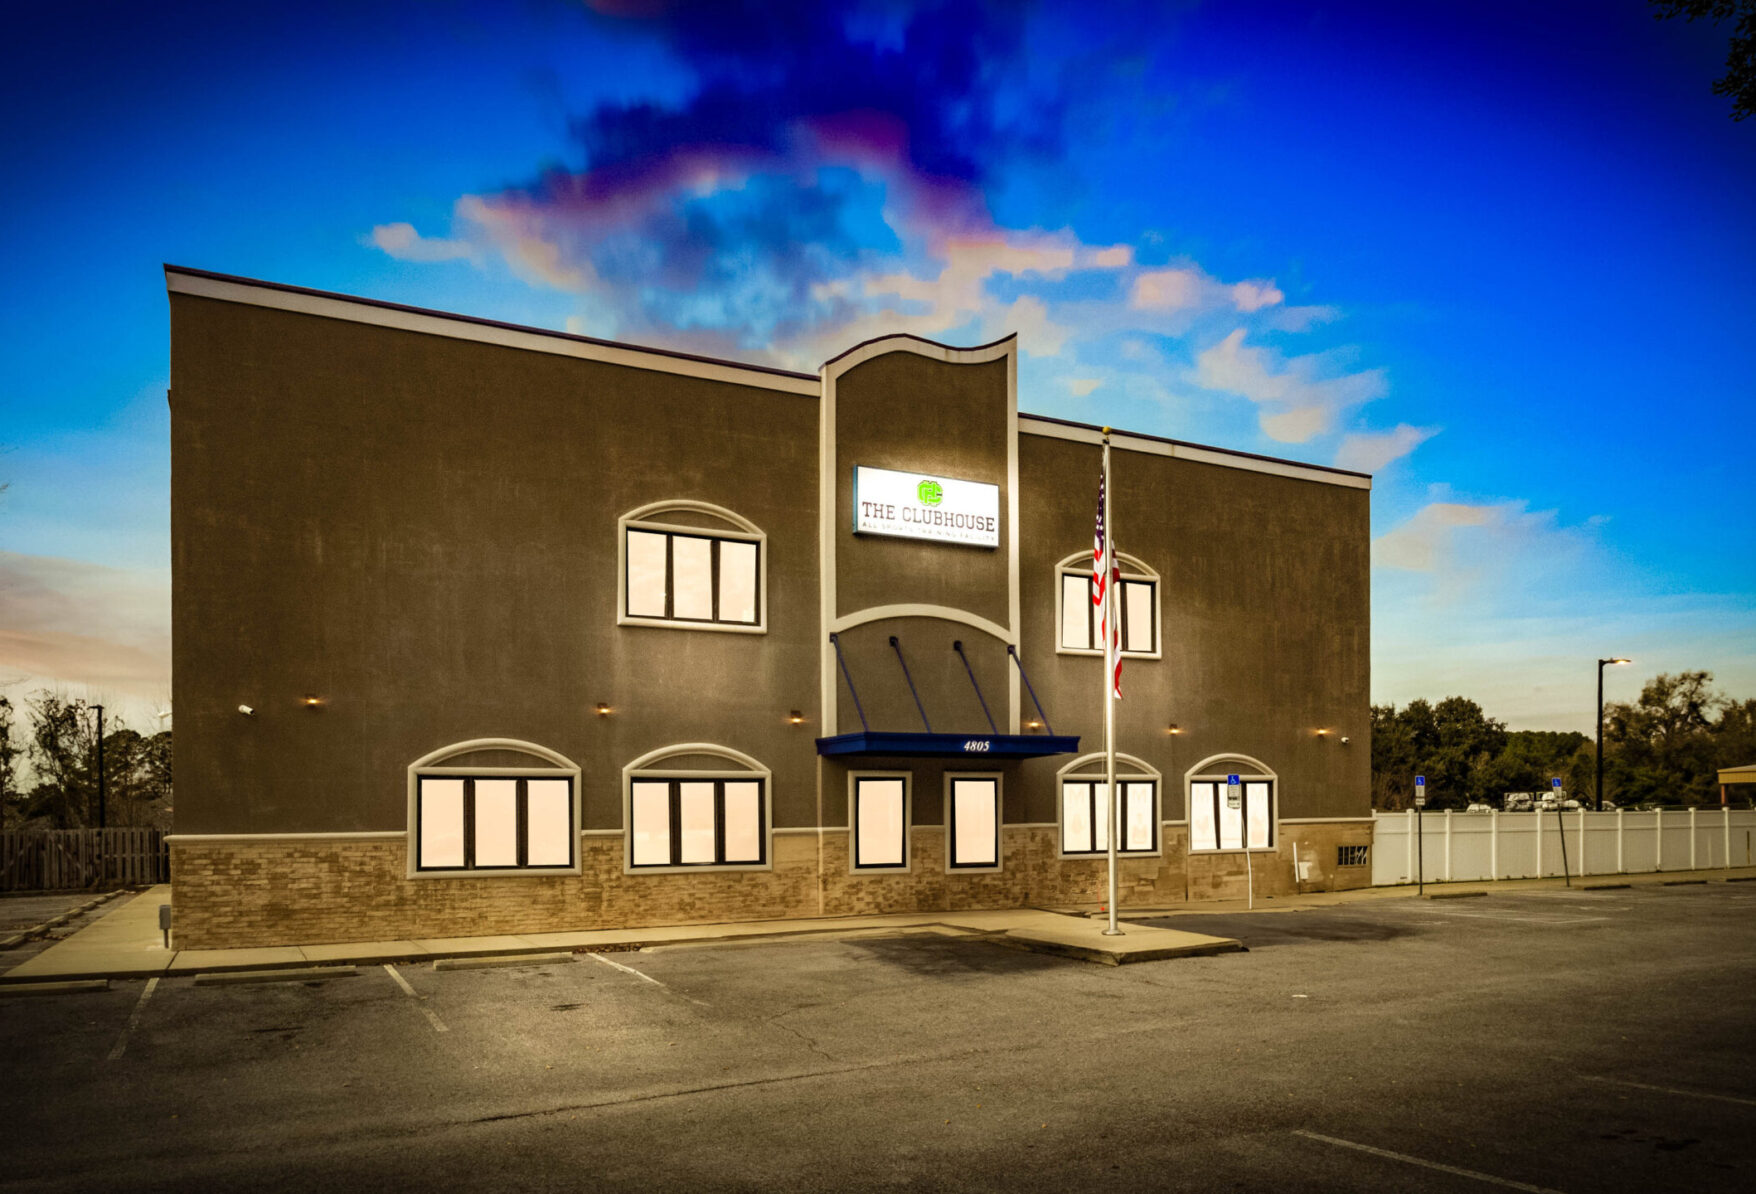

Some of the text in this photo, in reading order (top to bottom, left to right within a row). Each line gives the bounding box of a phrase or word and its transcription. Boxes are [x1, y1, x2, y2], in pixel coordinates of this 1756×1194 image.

[862, 501, 996, 532] THE CLUBHOUSE
[963, 740, 990, 752] 4805
